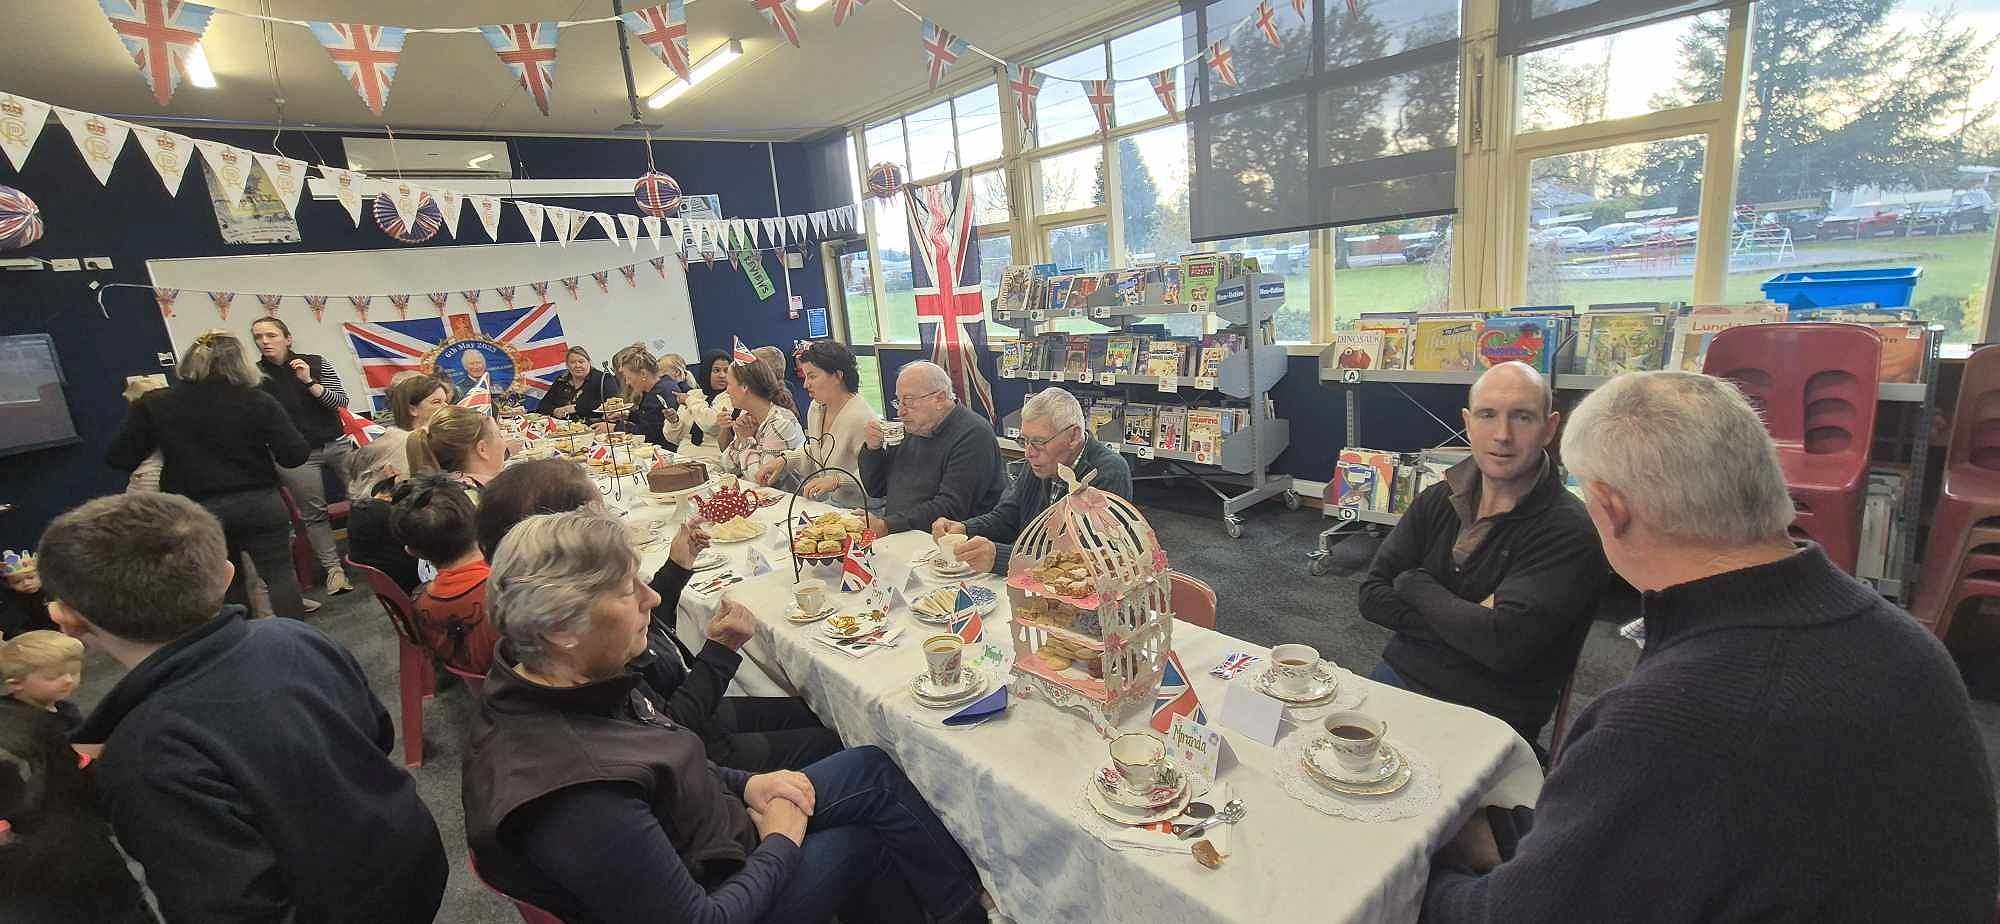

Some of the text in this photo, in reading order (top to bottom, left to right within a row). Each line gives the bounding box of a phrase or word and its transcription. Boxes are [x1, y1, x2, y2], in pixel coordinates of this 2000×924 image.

[445, 345, 458, 358] 6th
[458, 342, 474, 351] May
[1348, 371, 1356, 382] A
[1126, 426, 1151, 438] PLATE
[1344, 509, 1352, 520] D
